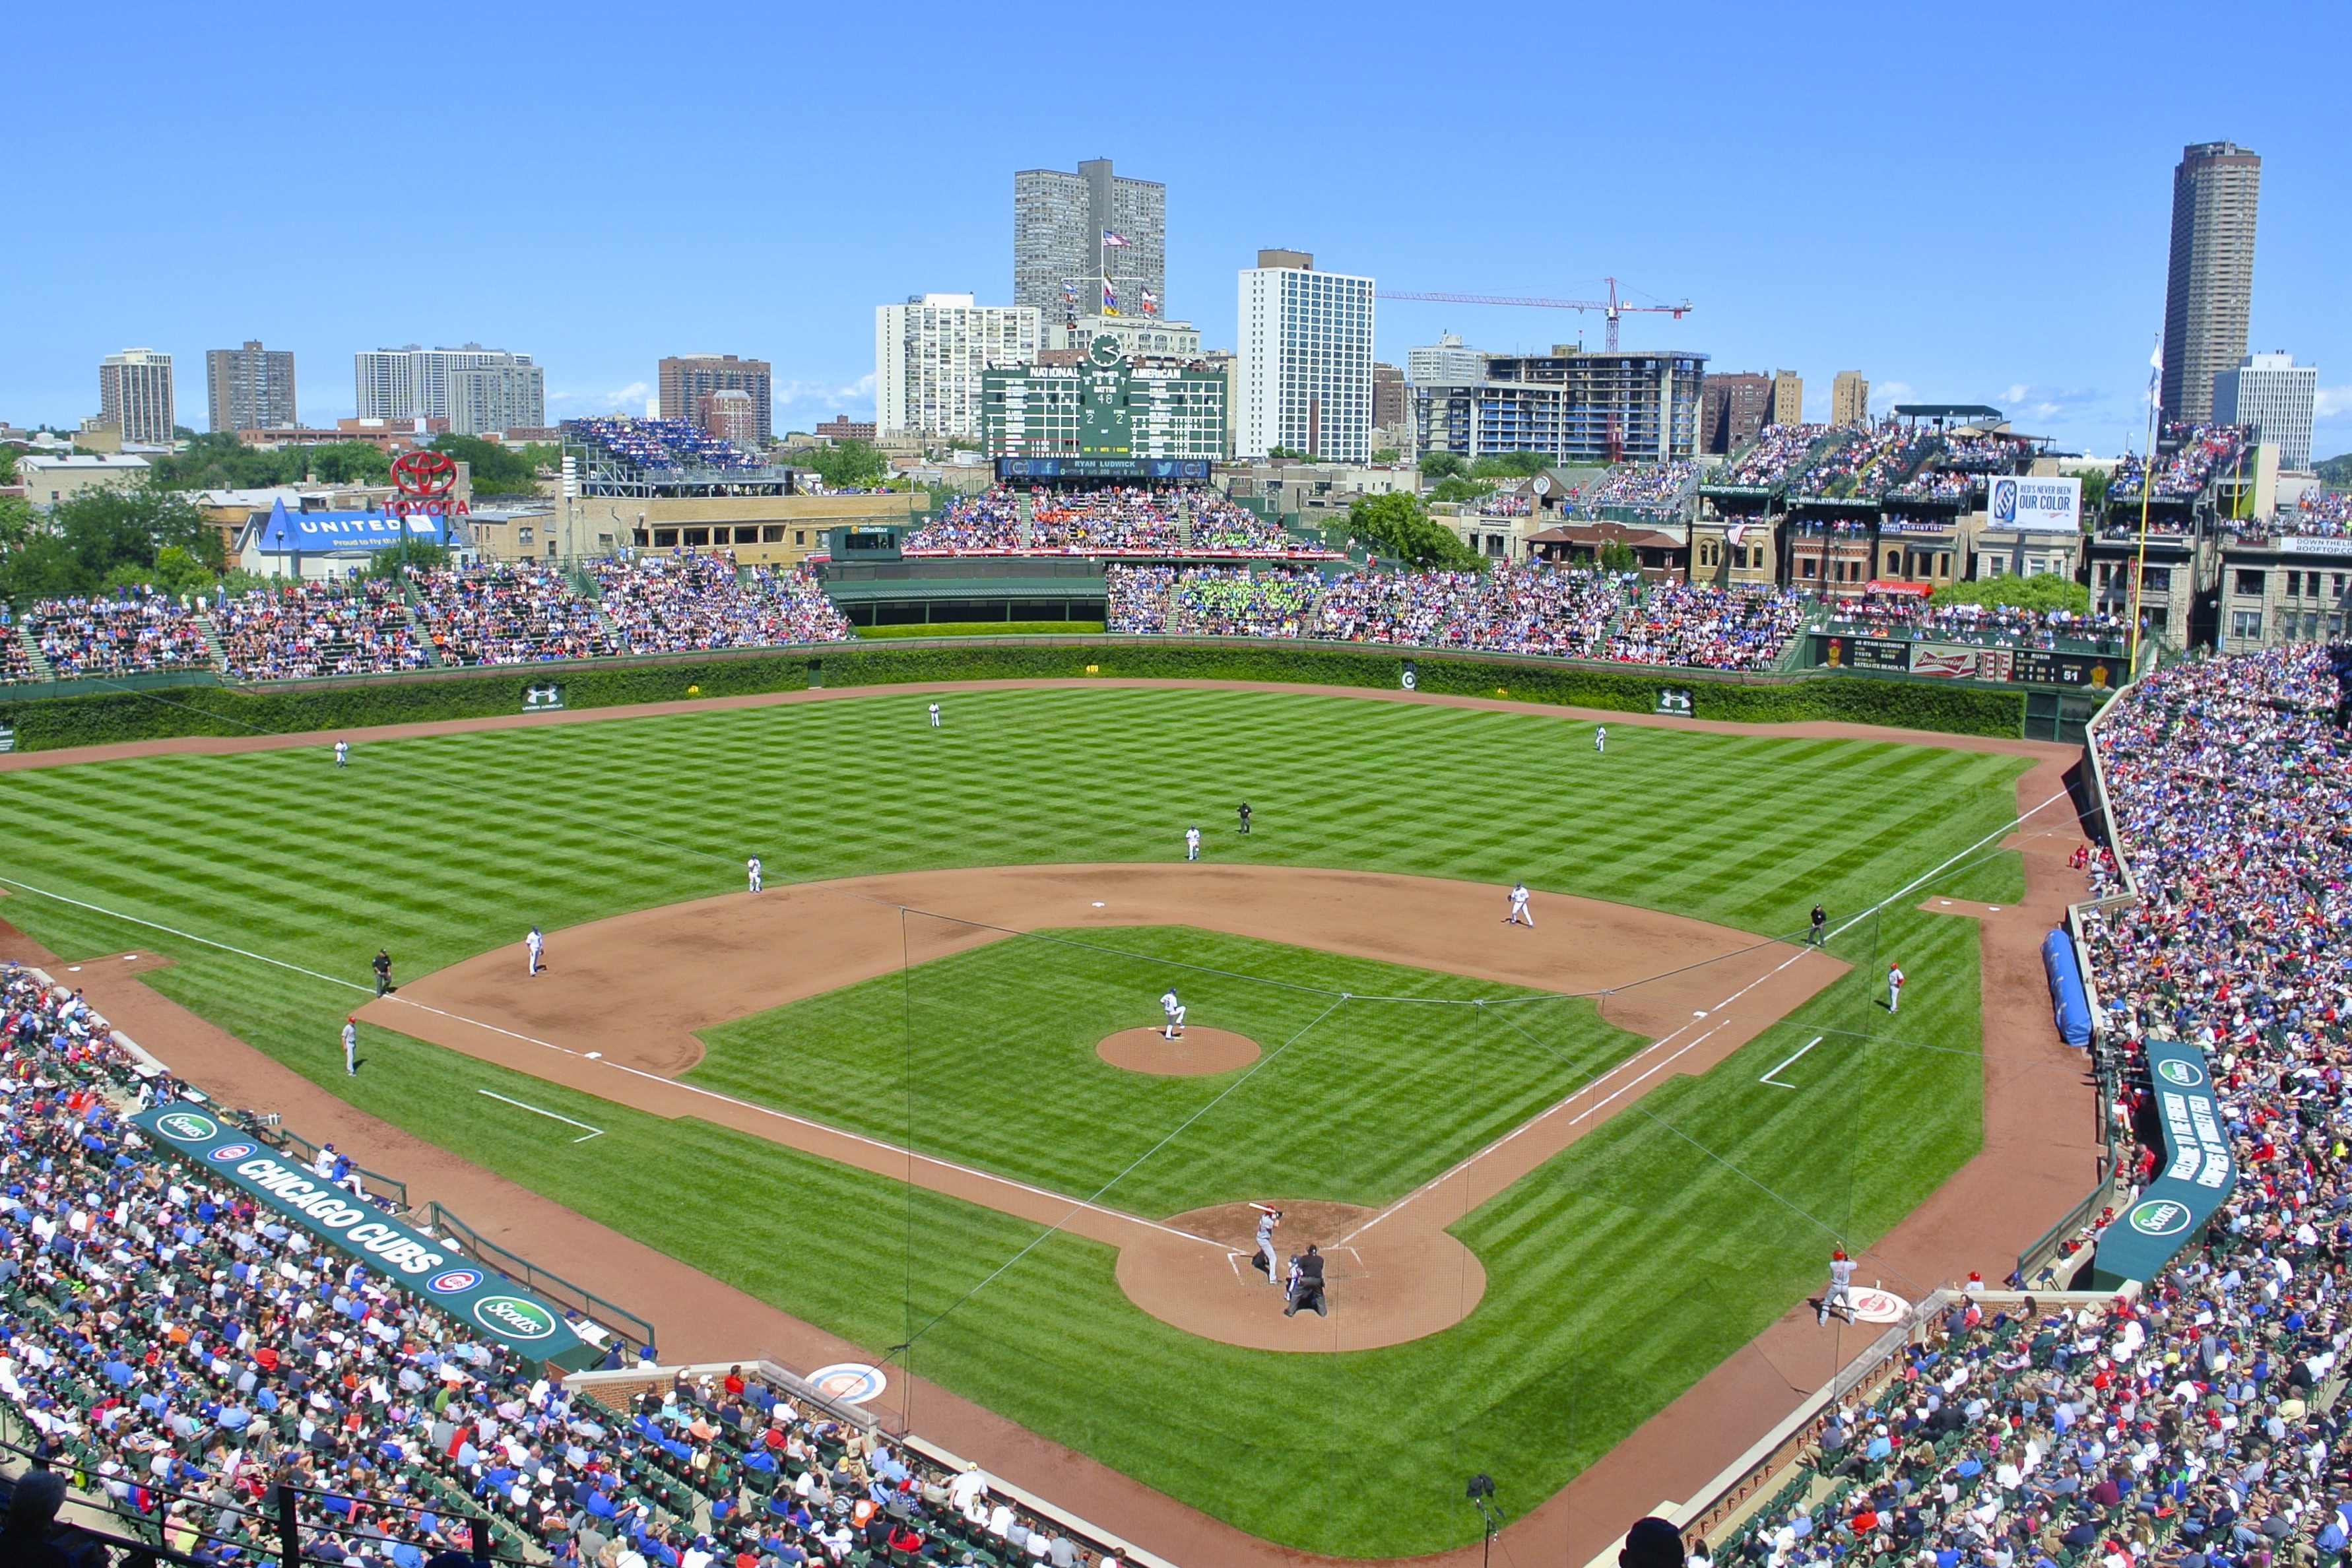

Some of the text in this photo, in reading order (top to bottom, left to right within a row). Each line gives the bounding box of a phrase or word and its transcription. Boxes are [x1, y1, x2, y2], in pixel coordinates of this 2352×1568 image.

[1030, 368, 1080, 377] NATIONAL
[1131, 368, 1181, 379] AMERICAN
[1097, 394, 1113, 404] 48
[1087, 414, 1094, 424] 2
[1117, 414, 1123, 424] 2
[1699, 484, 1769, 494] 3639wrigleyrooftop.com
[2020, 485, 2072, 495] RED'S NEVER BEEN
[2019, 495, 2037, 509] OUR
[381, 500, 470, 517] TOYOTA
[300, 519, 401, 533] UNITED
[370, 537, 381, 546] fly
[1866, 583, 1922, 595] Budweiser
[2064, 670, 2078, 682] 51
[166, 1117, 207, 1138] Scotts
[2169, 1121, 2194, 1135] THE
[2173, 1135, 2198, 1146] TO
[2167, 1146, 2201, 1181] WELCOME
[237, 1159, 443, 1274] CHICAGO CUBS
[2140, 1204, 2180, 1231] Scotts
[484, 1301, 543, 1335] Scotts
